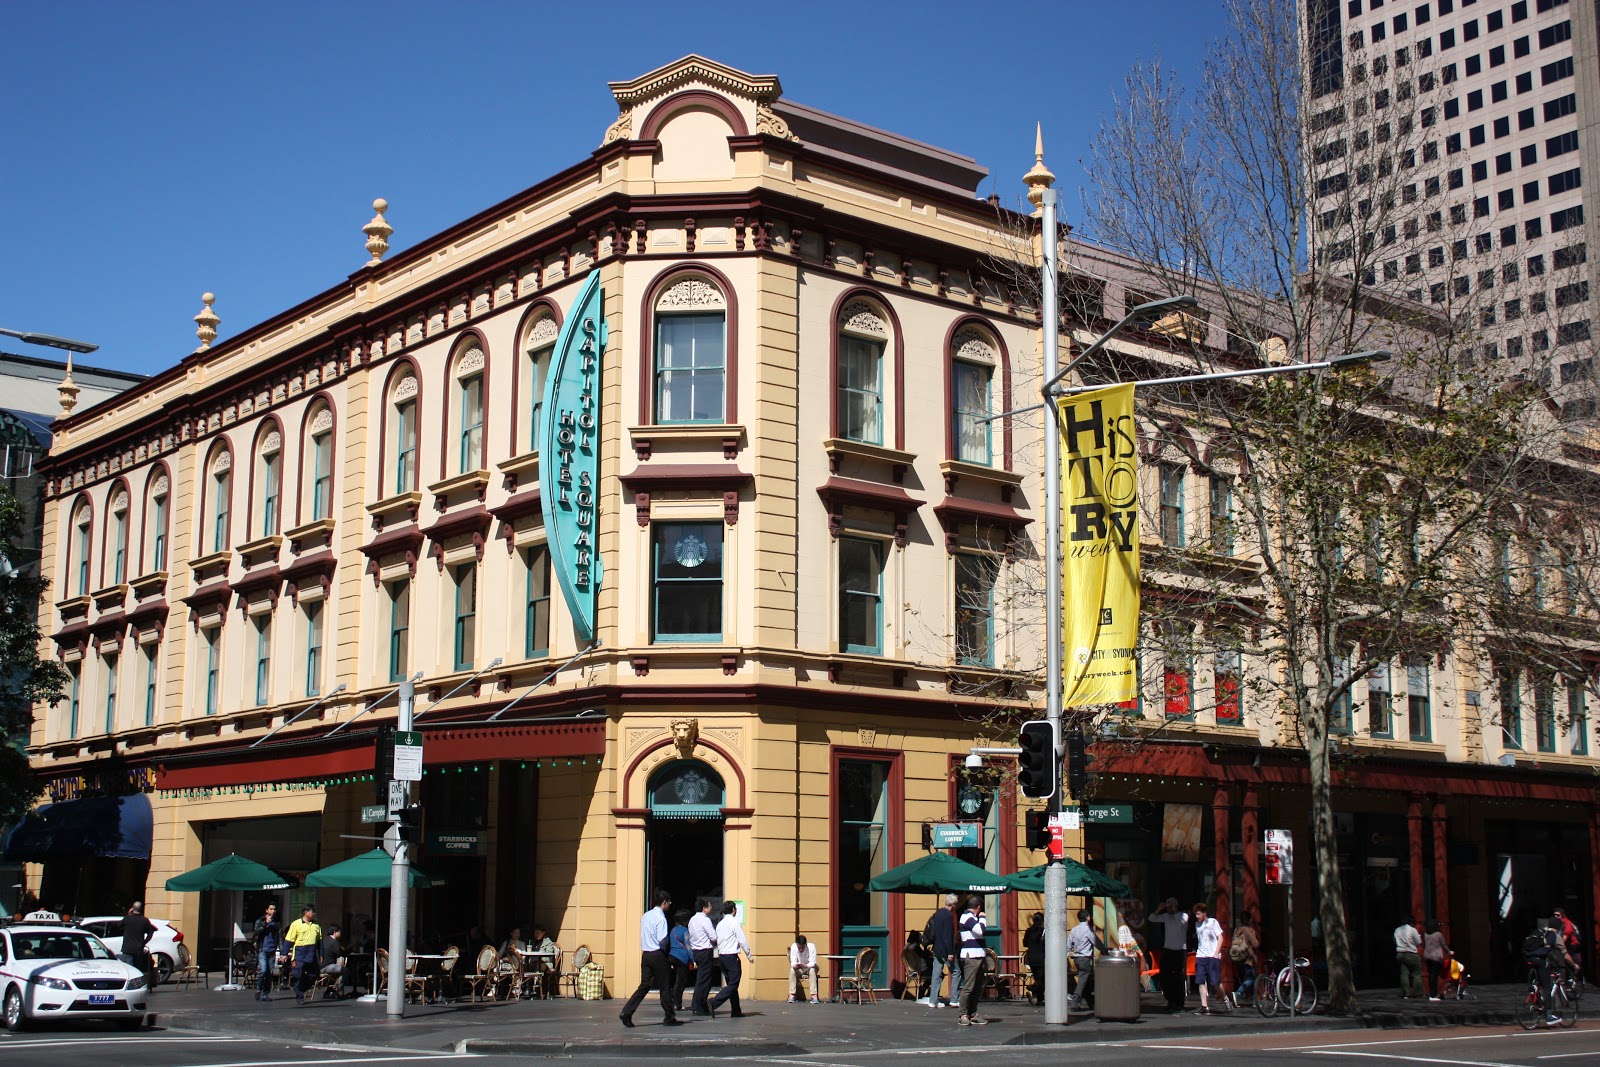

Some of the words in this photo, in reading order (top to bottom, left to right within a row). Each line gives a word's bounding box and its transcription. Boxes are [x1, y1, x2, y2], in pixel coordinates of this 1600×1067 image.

[578, 316, 596, 449] CAPITOL
[557, 408, 574, 503] HOTEL
[575, 471, 593, 586] SQUARE
[1112, 647, 1135, 660] SYDN
[391, 783, 403, 794] ONE
[390, 797, 403, 807] WAY
[1076, 807, 1109, 819] Gorge
[1110, 807, 1120, 817] St
[438, 835, 477, 843] STARBUCKS
[940, 829, 969, 837] STARBUCKS
